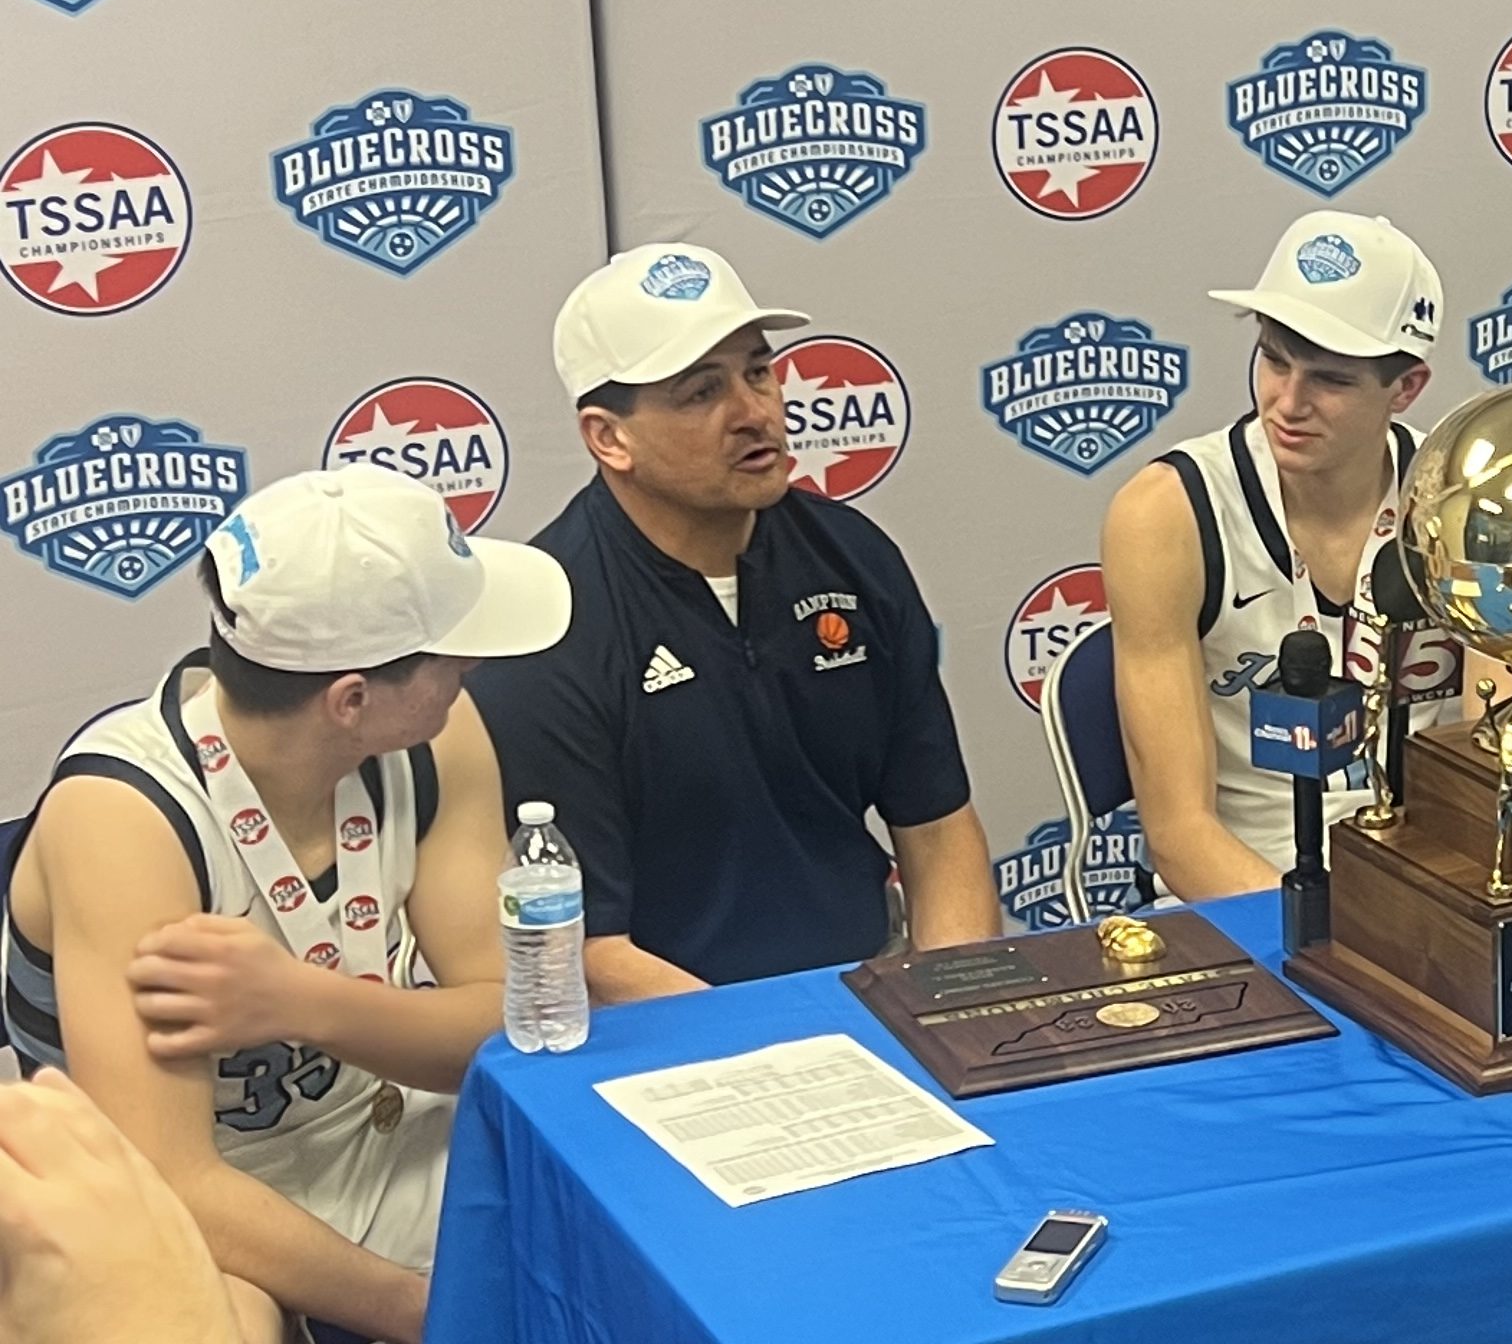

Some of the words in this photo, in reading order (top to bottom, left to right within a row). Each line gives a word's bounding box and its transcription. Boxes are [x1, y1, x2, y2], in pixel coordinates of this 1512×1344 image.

[1235, 65, 1418, 122] BLUECROSS
[710, 100, 916, 161] BLUECROSS
[1008, 106, 1143, 149] TSSAA
[1255, 115, 1290, 134] STATE
[1297, 106, 1401, 124] CHAMPIONSHIPS
[282, 128, 503, 196] BLUECROSS
[735, 153, 774, 173] STATE
[781, 144, 898, 161] CHAMPIONSHIPS
[1017, 148, 1135, 166] CHAMPIONSHIPS
[6, 186, 174, 239] TSSAA
[310, 185, 352, 208] STATE
[359, 174, 484, 193] CHAMPIONSHIPS
[20, 232, 165, 258] CHAMPIONSHIPS
[990, 346, 1180, 405] BLUECROSS
[784, 392, 895, 435] SSAA
[1011, 396, 1048, 416] STATE
[1054, 386, 1162, 403] CHAMPIONSHIPS
[4, 452, 237, 525] BLUECROSS
[33, 511, 77, 536] STATE
[85, 497, 217, 519] CHAMPIONSHIPS
